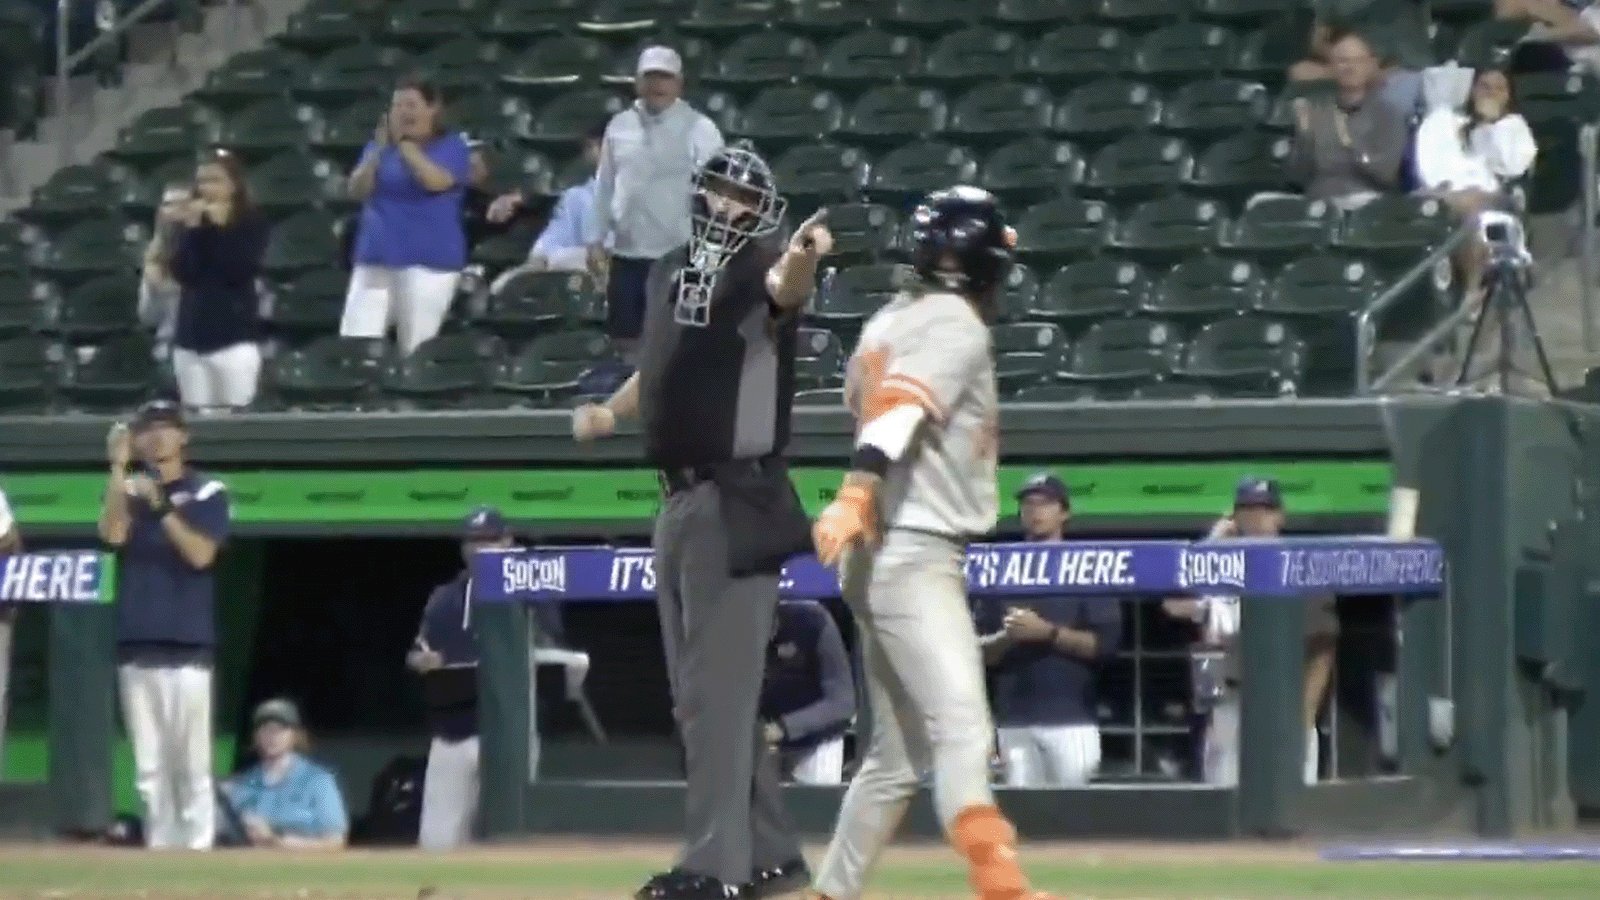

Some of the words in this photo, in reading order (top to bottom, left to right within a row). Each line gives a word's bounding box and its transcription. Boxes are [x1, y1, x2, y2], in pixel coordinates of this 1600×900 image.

[609, 556, 657, 592] IT'S
[1003, 551, 1050, 585] ALL
[1058, 550, 1135, 585] HERE.
